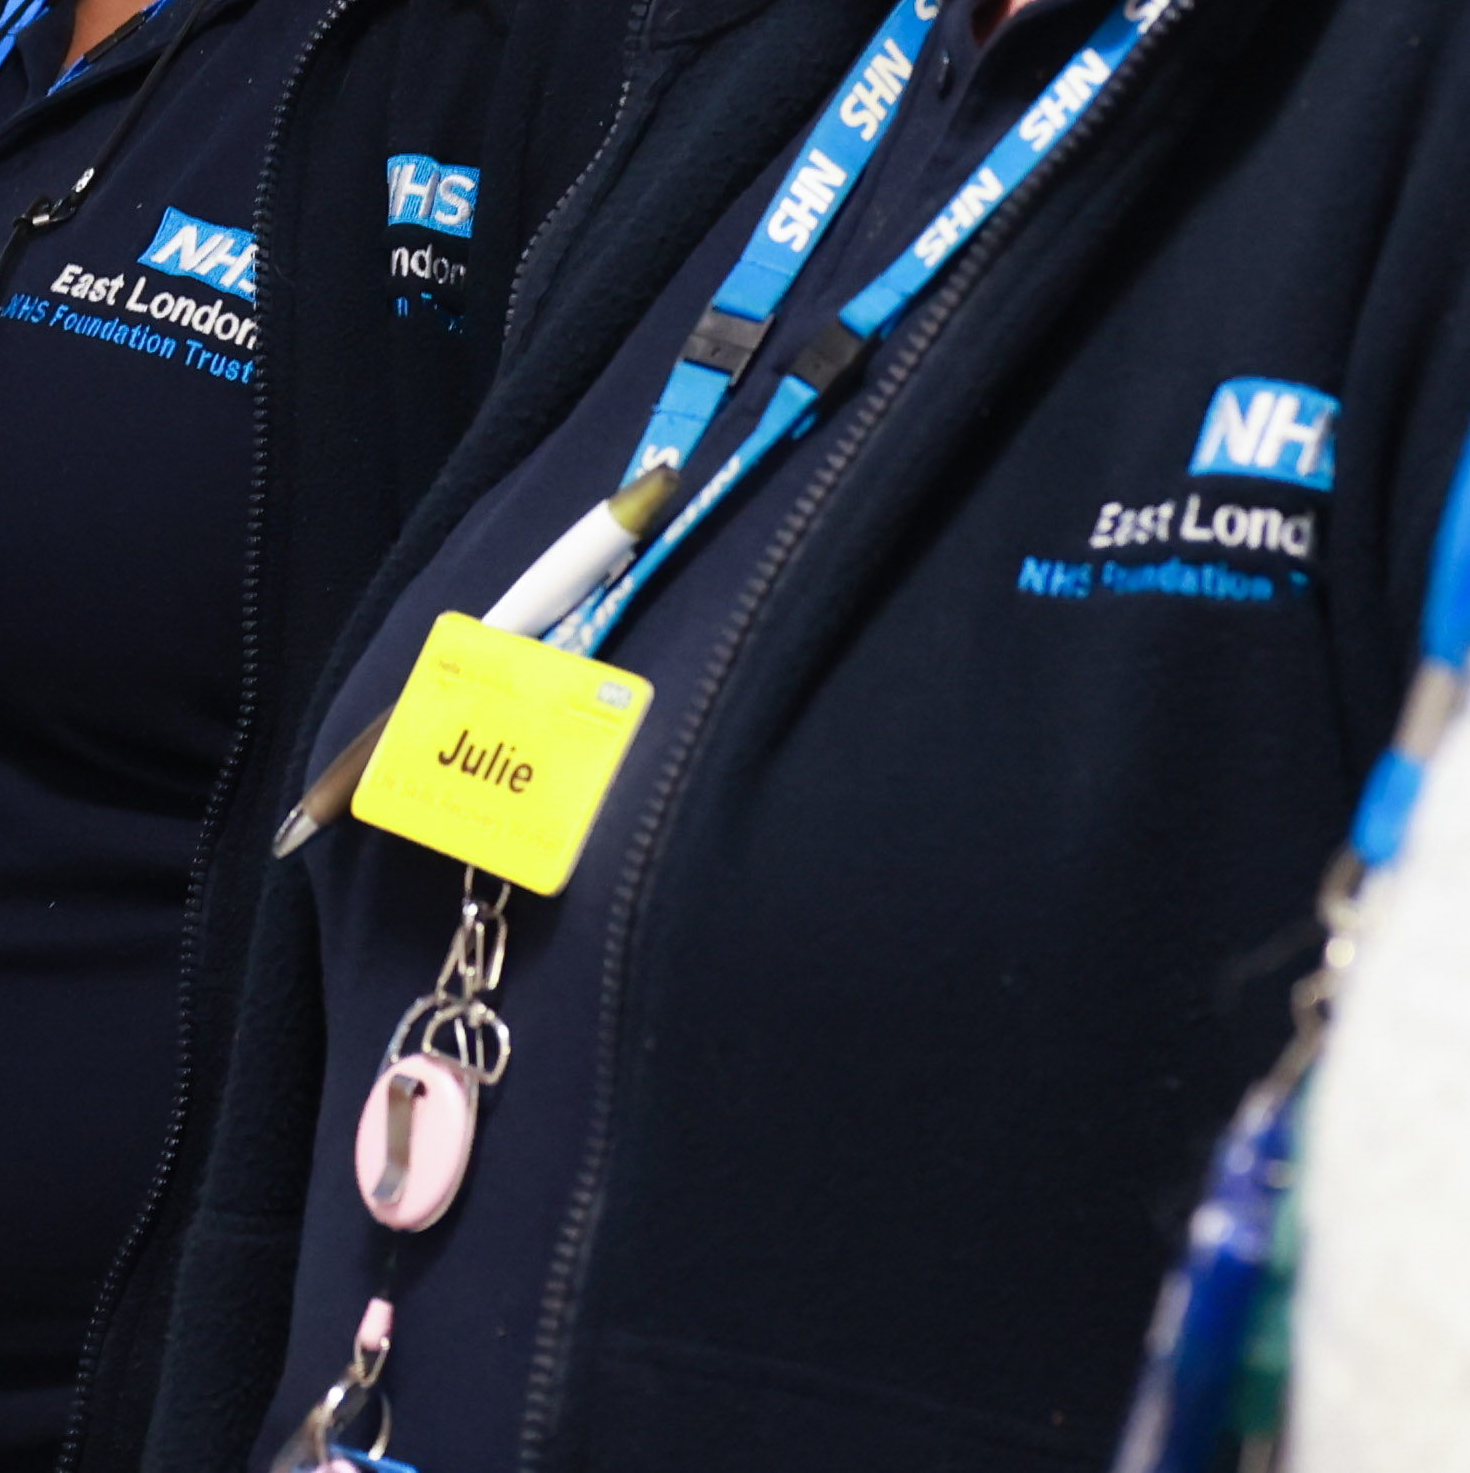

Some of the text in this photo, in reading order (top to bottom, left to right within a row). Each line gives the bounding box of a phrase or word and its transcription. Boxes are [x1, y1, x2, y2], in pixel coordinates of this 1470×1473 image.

[840, 40, 914, 140] NHS
[1020, 49, 1110, 152] NHS
[767, 149, 847, 252] NHS
[914, 170, 1004, 267] NHS
[151, 225, 256, 293] NH
[0, 293, 254, 384] NHS Foundation Trust
[50, 263, 258, 350] East London
[1193, 390, 1331, 476] NH
[1180, 492, 1315, 559] Lond
[437, 729, 534, 794] Julie
